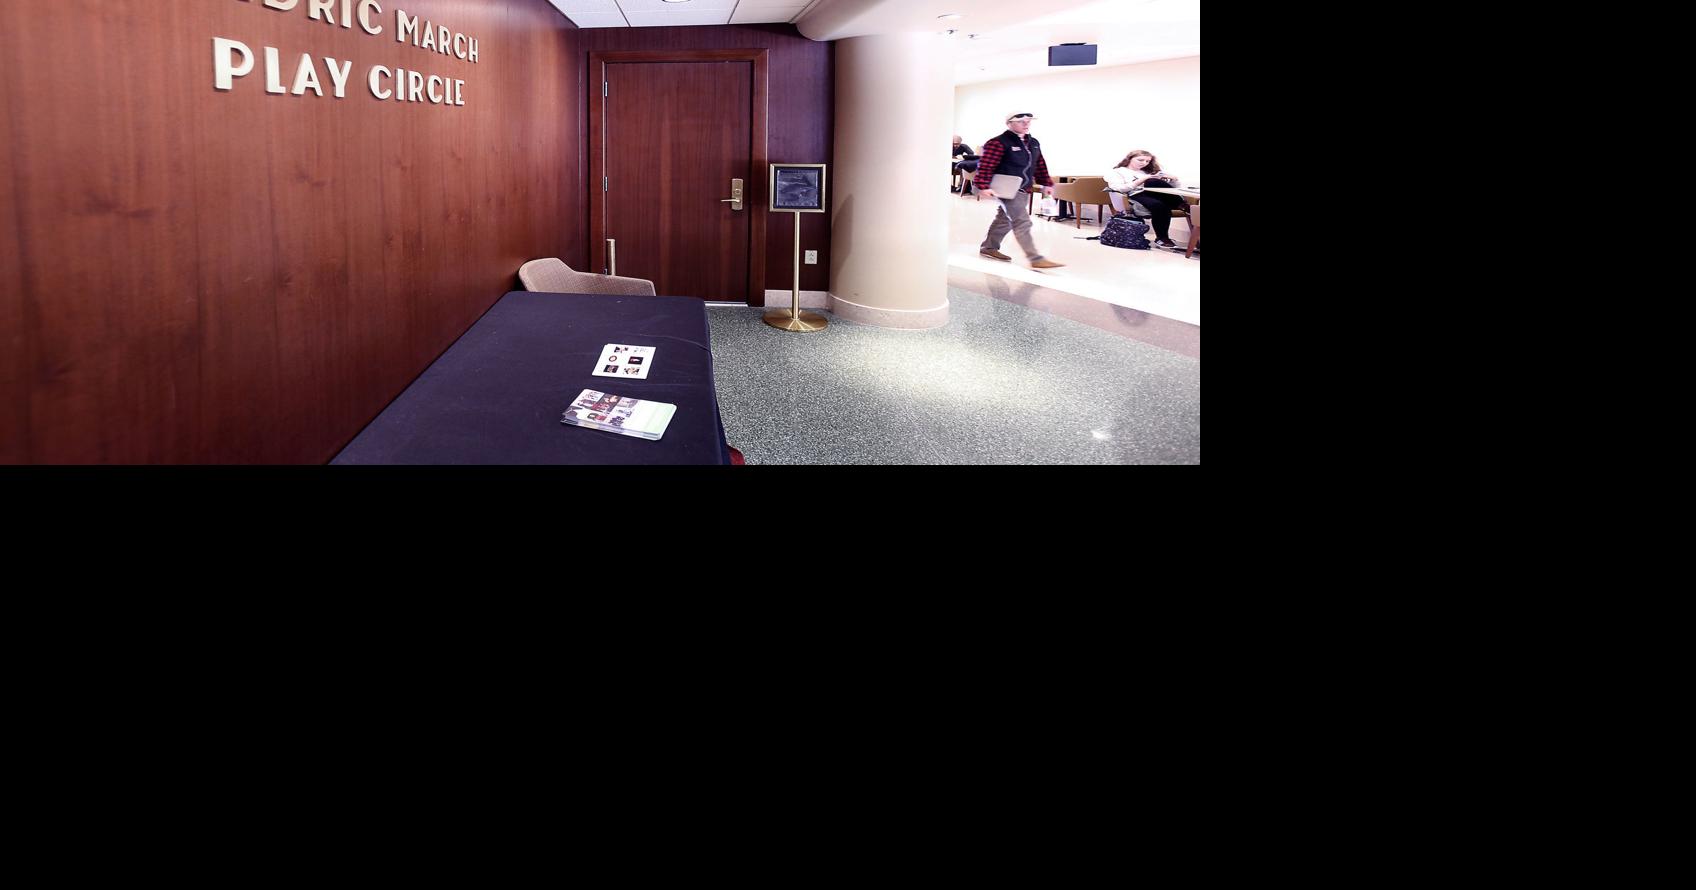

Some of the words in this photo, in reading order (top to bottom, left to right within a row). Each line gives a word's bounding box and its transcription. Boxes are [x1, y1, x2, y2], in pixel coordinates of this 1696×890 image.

[237, 0, 383, 35] RIC
[396, 9, 479, 63] MARCH
[213, 37, 352, 98] PLAY
[368, 64, 466, 106] CIRCLE
